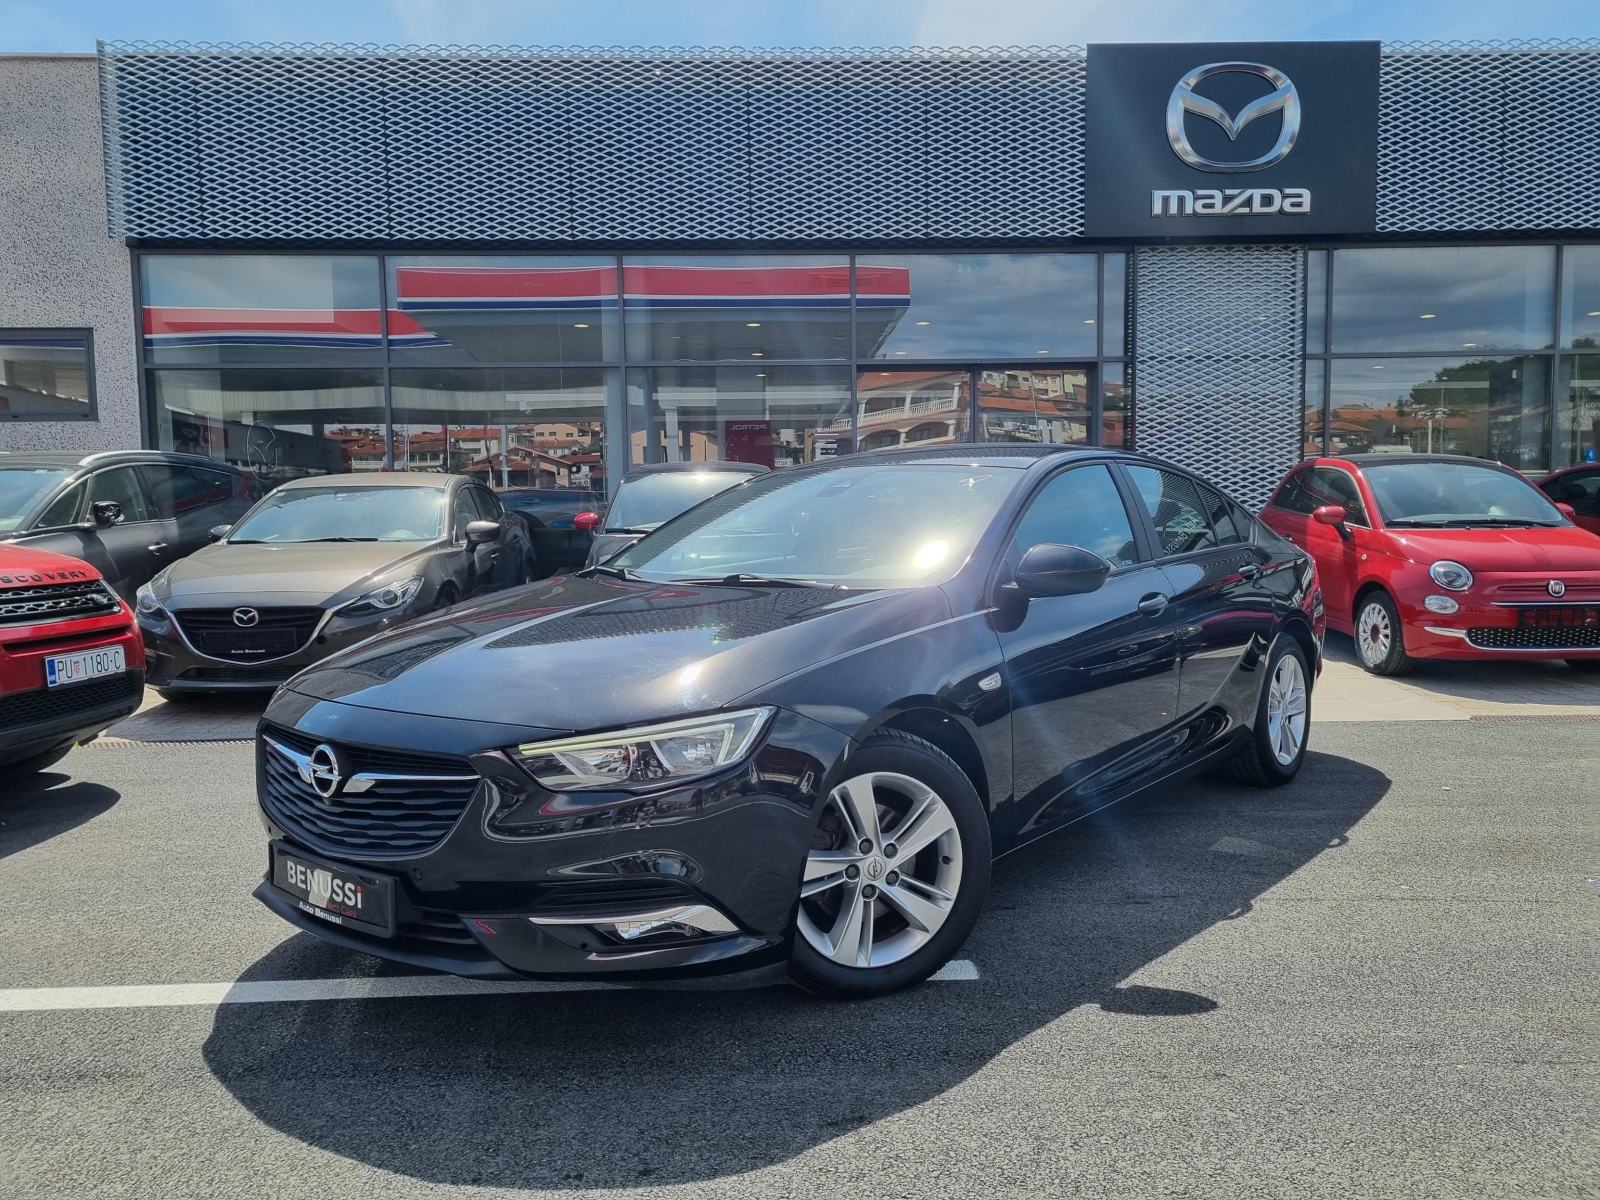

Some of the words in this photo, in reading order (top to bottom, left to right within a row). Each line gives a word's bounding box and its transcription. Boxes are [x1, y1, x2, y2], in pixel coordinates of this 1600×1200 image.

[1151, 188, 1311, 217] mazda
[298, 900, 314, 914] Auto
[314, 907, 342, 925] Benussi
